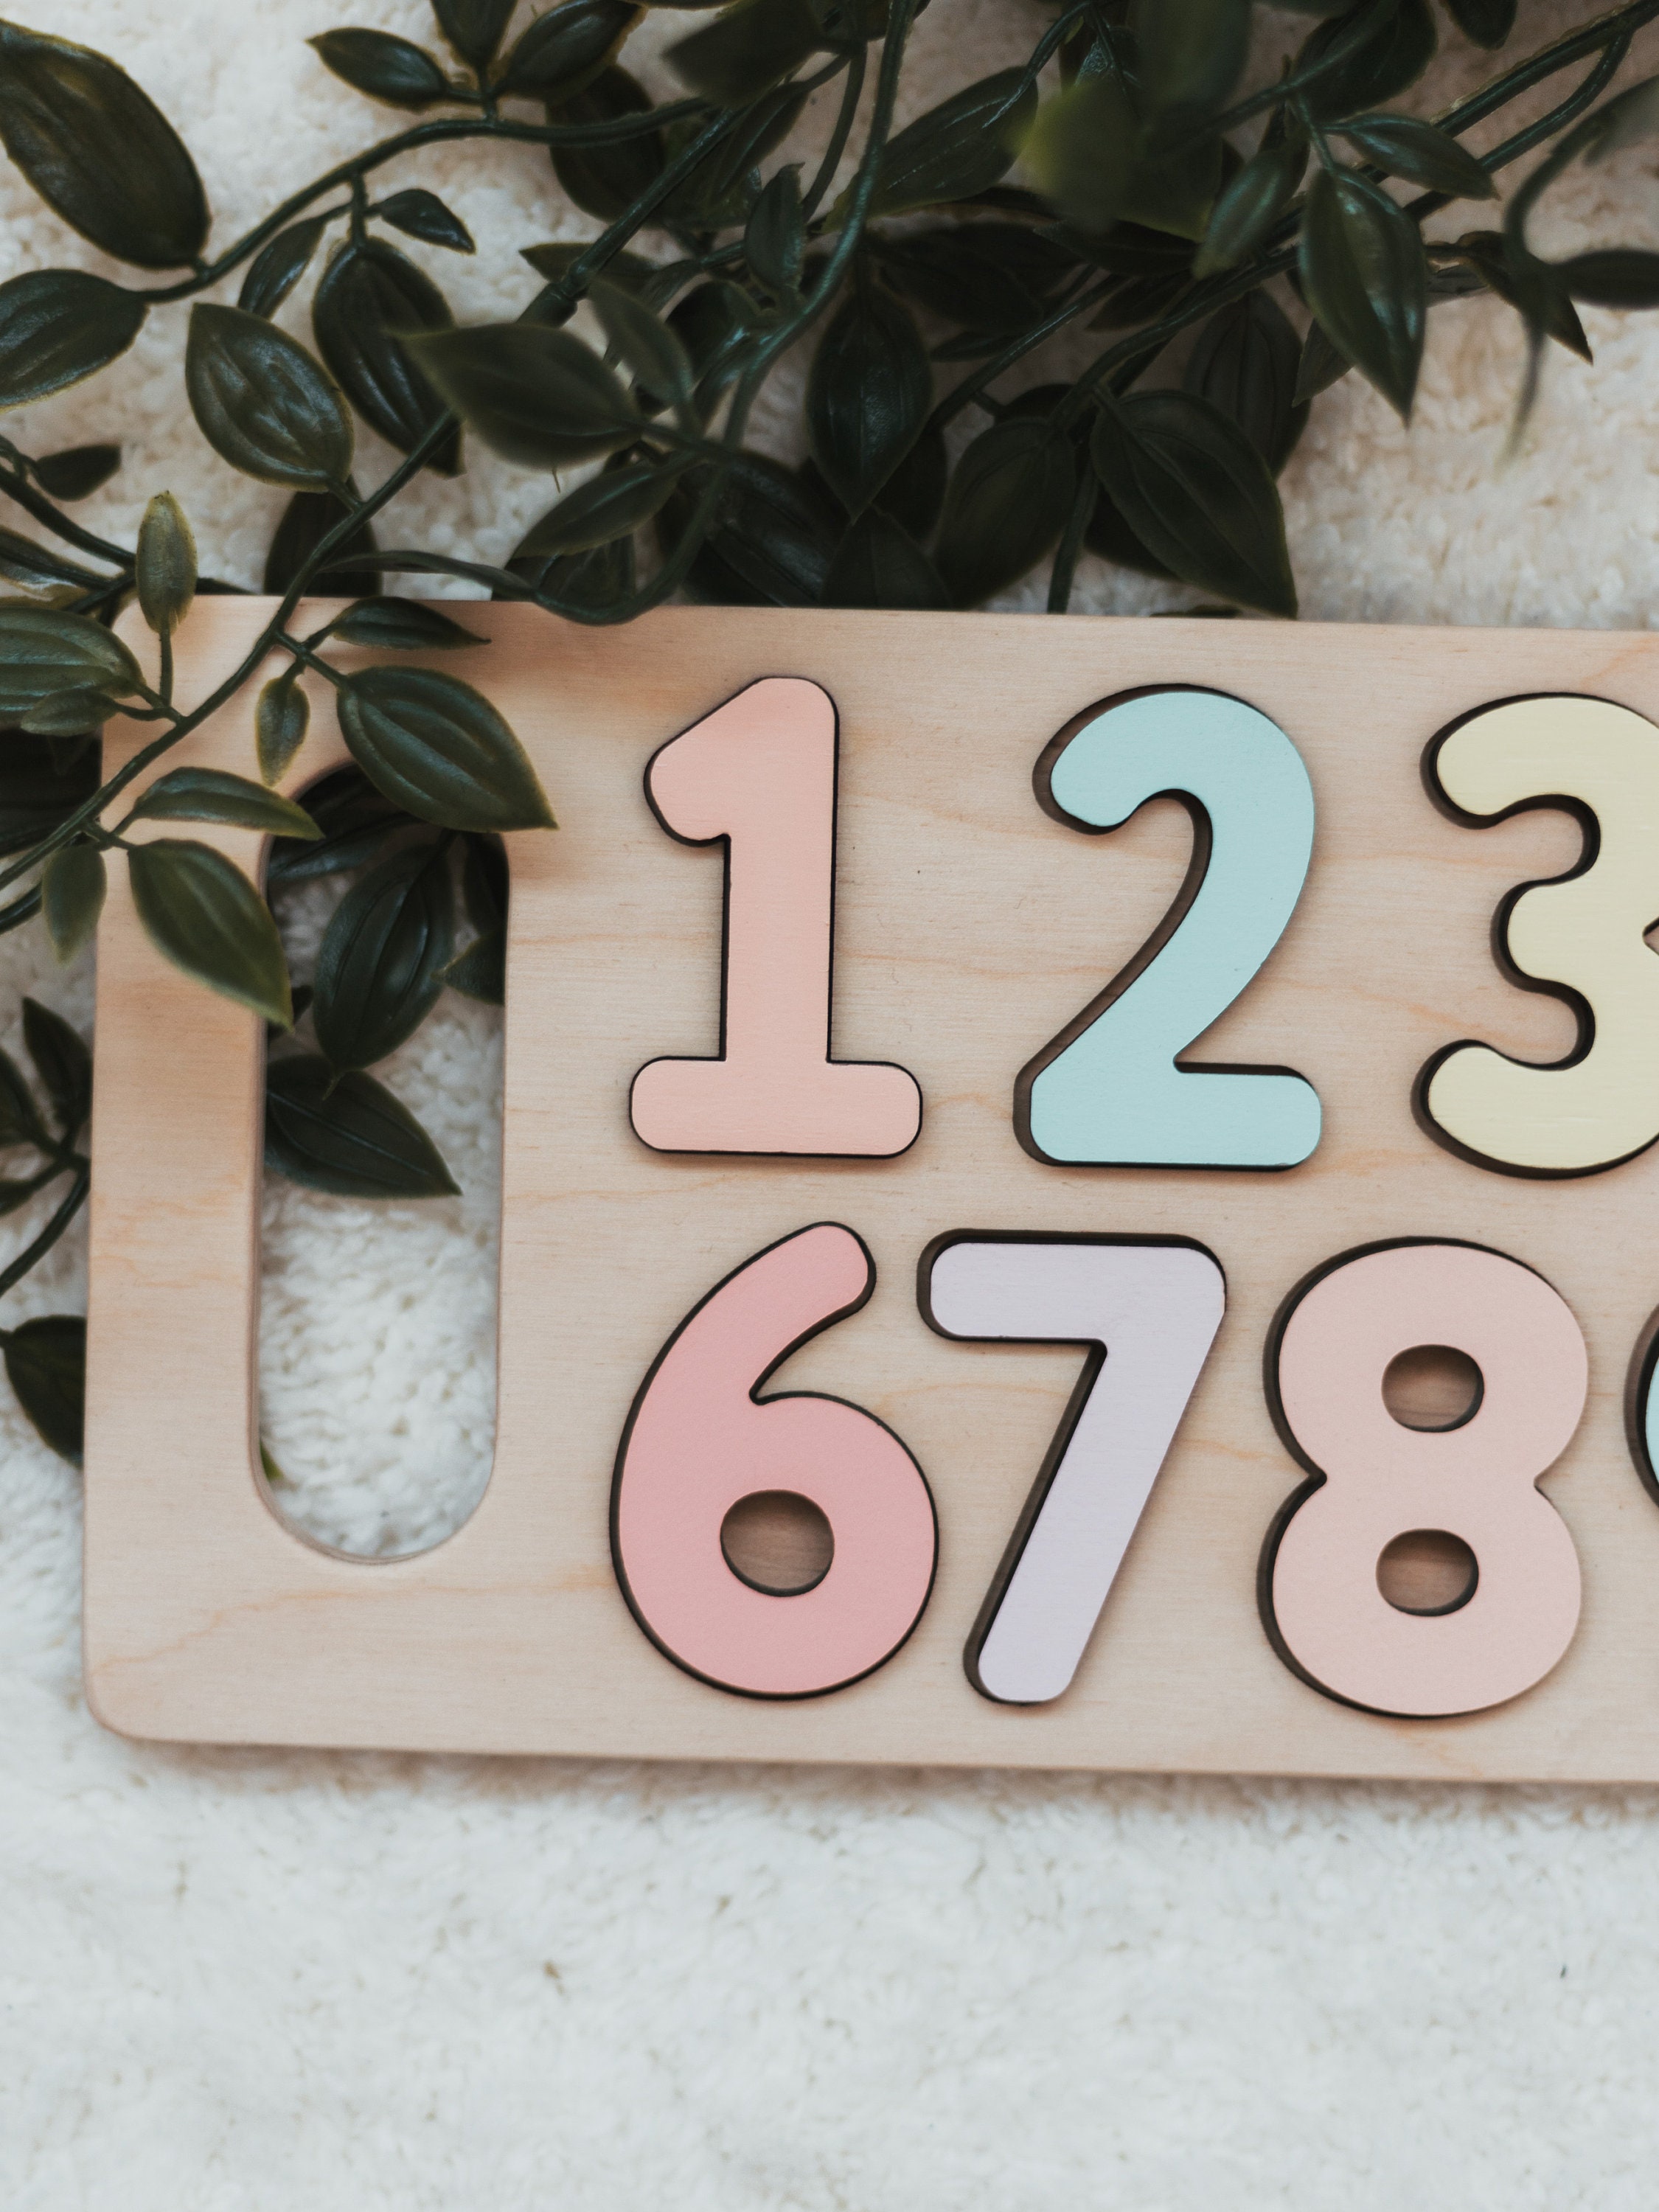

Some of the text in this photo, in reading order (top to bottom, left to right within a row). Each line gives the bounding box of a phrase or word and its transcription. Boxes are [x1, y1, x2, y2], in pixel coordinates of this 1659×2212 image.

[630, 676, 1659, 1170] 1 2 3
[616, 1222, 936, 1695] 6
[929, 1242, 1226, 1702] 7
[1272, 1245, 1588, 1717] 8
